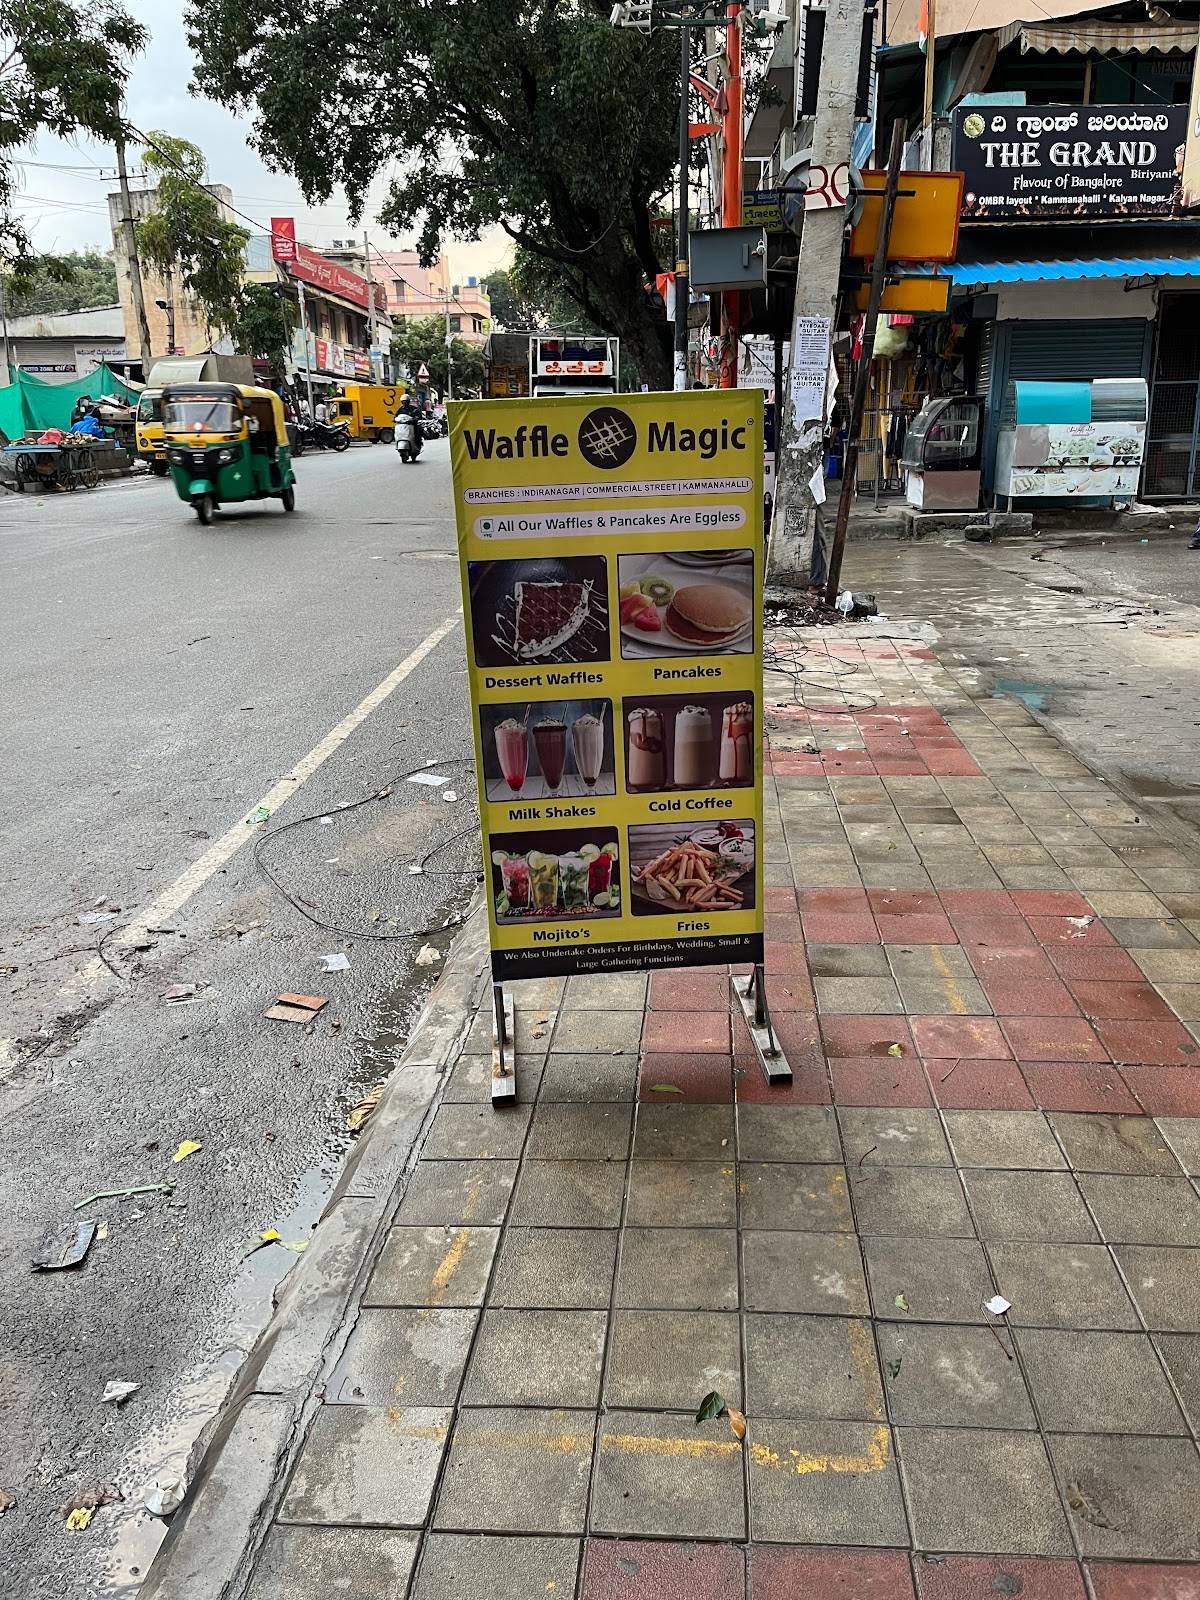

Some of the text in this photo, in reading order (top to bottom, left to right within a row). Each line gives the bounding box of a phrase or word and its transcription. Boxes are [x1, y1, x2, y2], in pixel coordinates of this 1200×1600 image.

[990, 112, 1169, 138] ದಿ ಗ್ರಾಂಡ್ ಬಿರಿಯಾನಿ
[980, 141, 1158, 168] THE GRAND
[1013, 172, 1123, 190] Flavour Of Bangalore
[1130, 168, 1172, 182] Biriyani
[978, 193, 1165, 206] OMBR layout Kammanahalli Kalyan Nagar
[463, 425, 569, 460] Waffle
[648, 418, 746, 459] Magic
[468, 480, 749, 499] BRANCHES INDIRANAGAR COMMERCIAL STREET KAMMANAHALLI
[498, 512, 740, 532] All Our Waffles & Pancakes Are Eggless
[485, 672, 604, 688] Dessert Waffles
[654, 666, 722, 680] Pancakes
[648, 797, 733, 812] Cold Coffee
[508, 806, 596, 820] Milk Shakes
[677, 920, 710, 932] Fries
[533, 928, 591, 942] Mojito's
[522, 951, 540, 959] Also
[542, 948, 585, 958] Undertake
[587, 946, 616, 955] Orders
[634, 942, 674, 952] Birthdays,
[676, 940, 716, 950] Wedding,
[718, 938, 741, 946] Small
[744, 937, 750, 945] &
[576, 954, 684, 968] Large Gathering Functions
